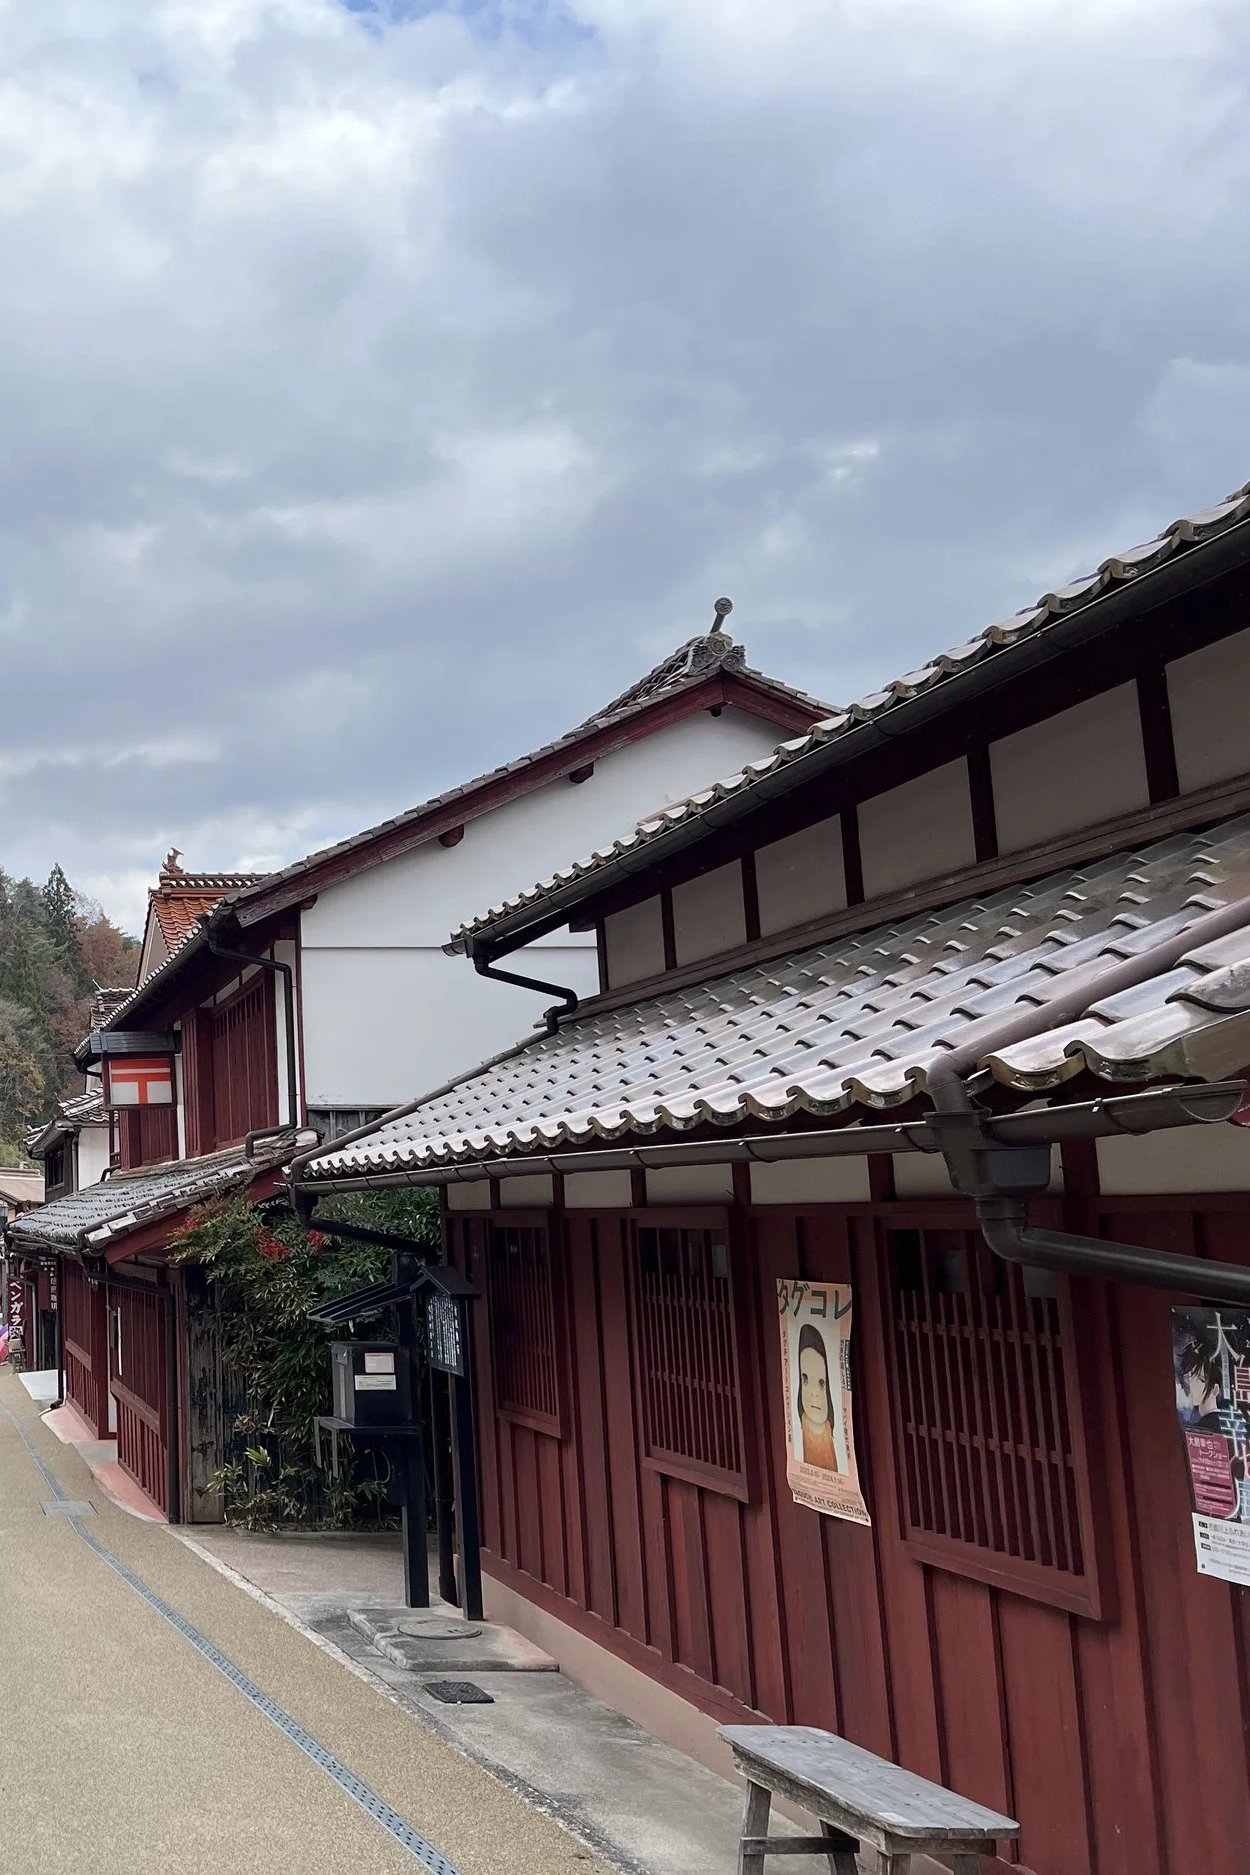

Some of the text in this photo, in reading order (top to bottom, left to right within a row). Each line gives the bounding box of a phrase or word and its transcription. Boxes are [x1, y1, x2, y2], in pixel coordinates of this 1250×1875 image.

[778, 1280, 852, 1320] タグコレ
[1199, 1449, 1227, 1460] トークショー
[827, 1499, 867, 1517] COLLECTION
